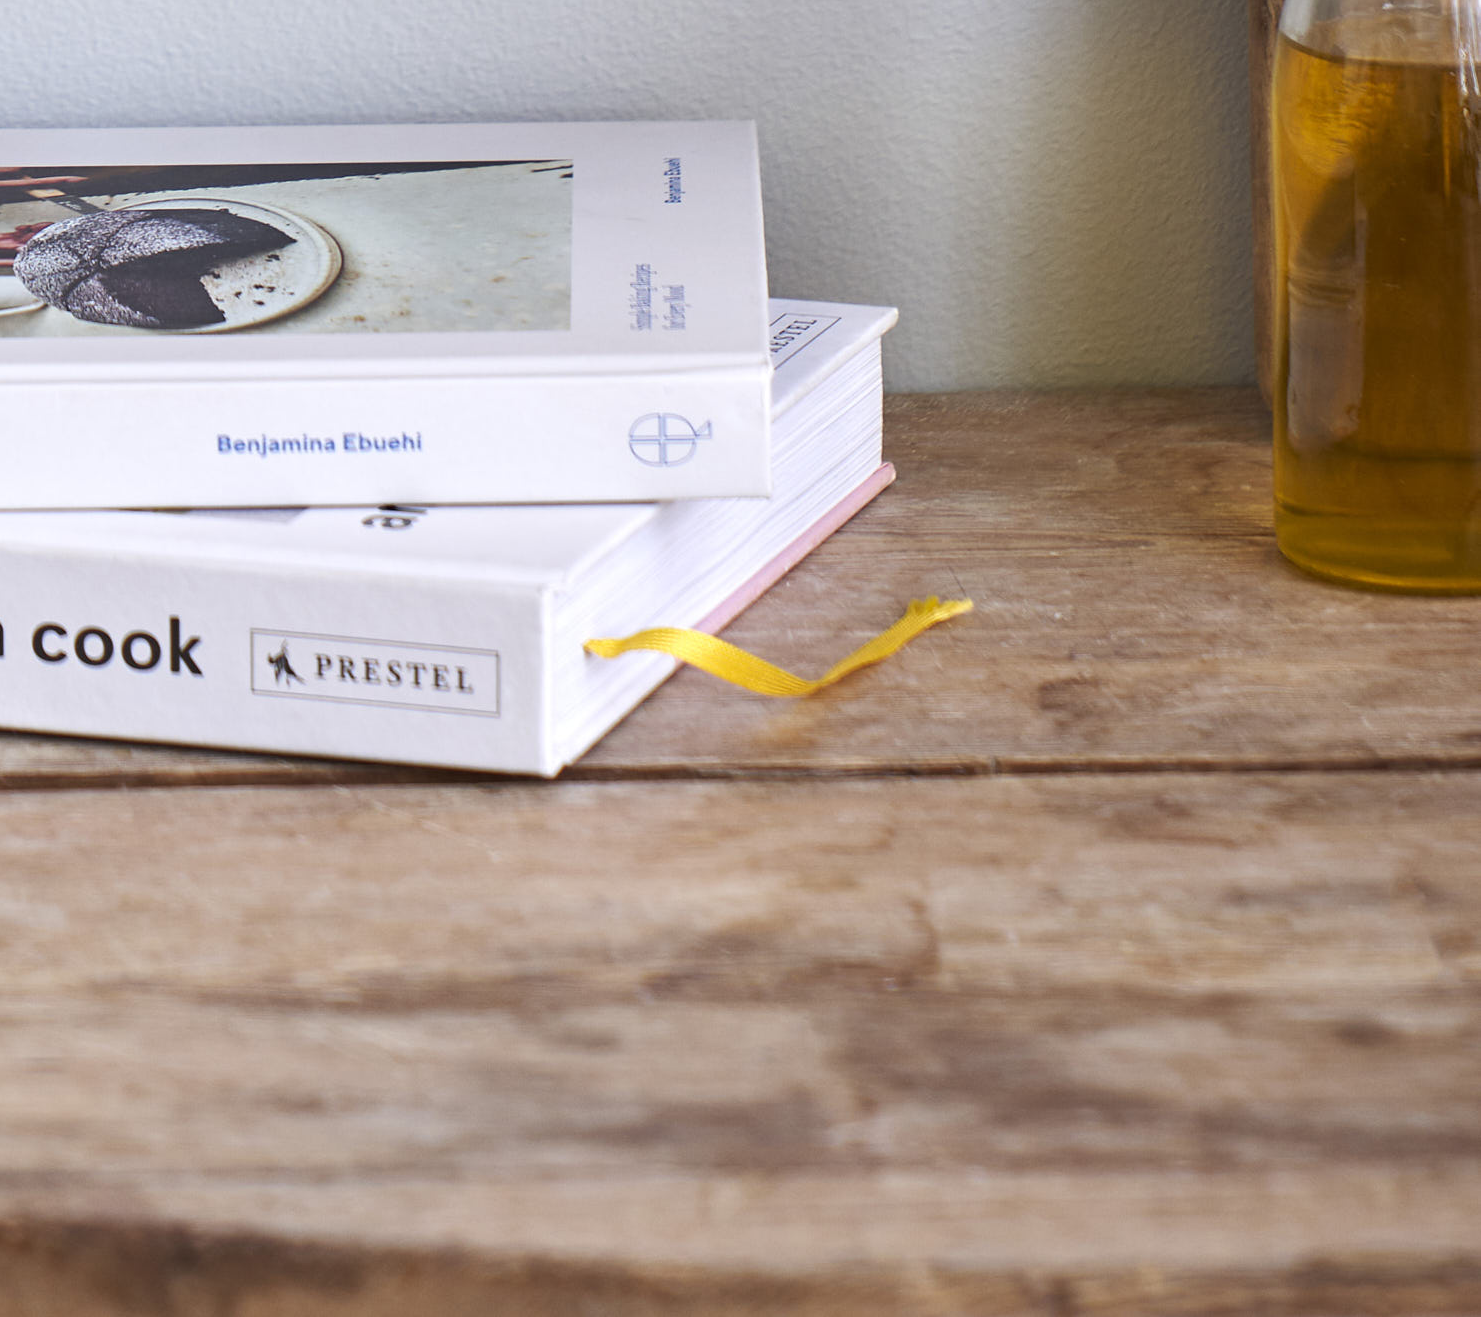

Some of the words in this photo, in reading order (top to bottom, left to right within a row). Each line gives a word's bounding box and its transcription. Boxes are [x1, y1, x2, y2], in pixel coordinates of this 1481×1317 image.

[769, 318, 818, 354] ESTEL
[217, 434, 336, 458] Benjamina
[342, 432, 422, 452] Ebuehi
[30, 616, 204, 677] cook
[315, 653, 476, 694] PRESTEL
